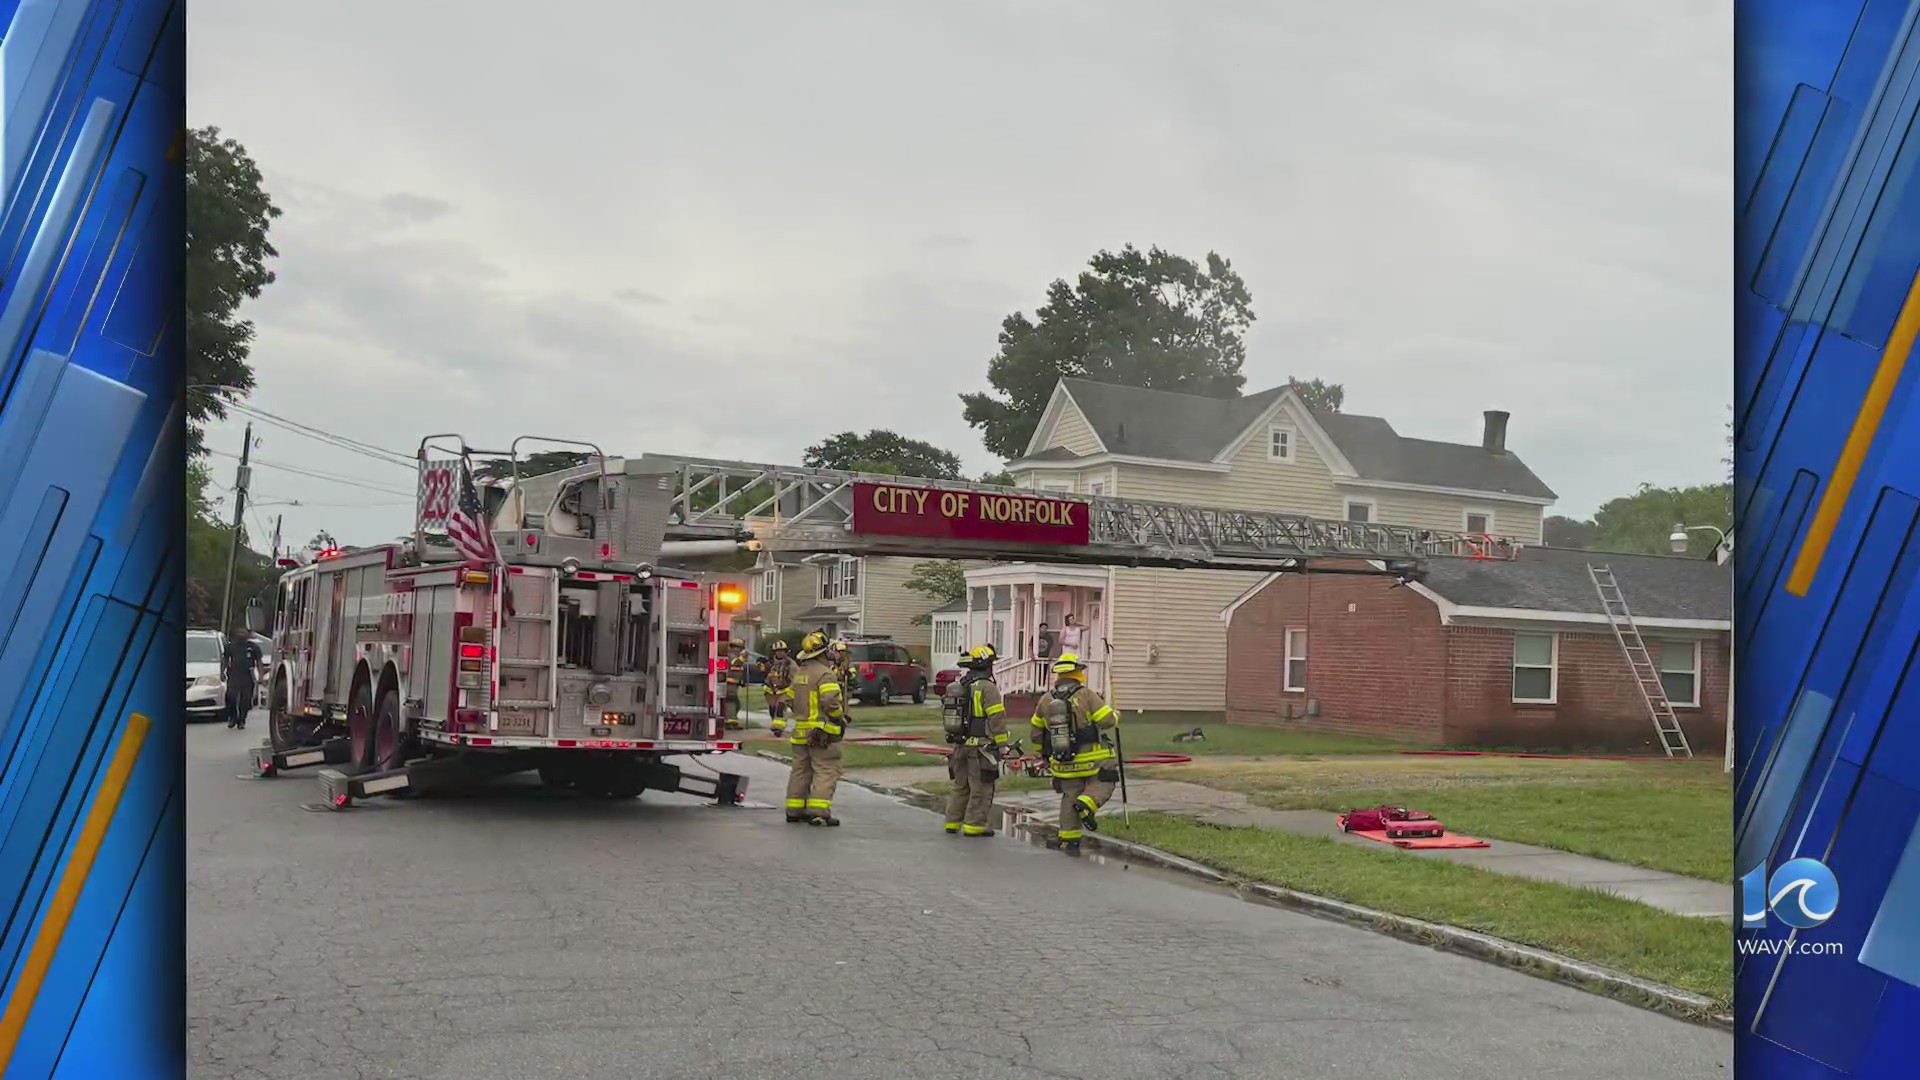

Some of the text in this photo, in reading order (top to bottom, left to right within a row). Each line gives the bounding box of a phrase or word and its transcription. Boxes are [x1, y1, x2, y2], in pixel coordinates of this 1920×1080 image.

[423, 468, 451, 520] 23
[873, 487, 1075, 526] CITY OF NORFOLK
